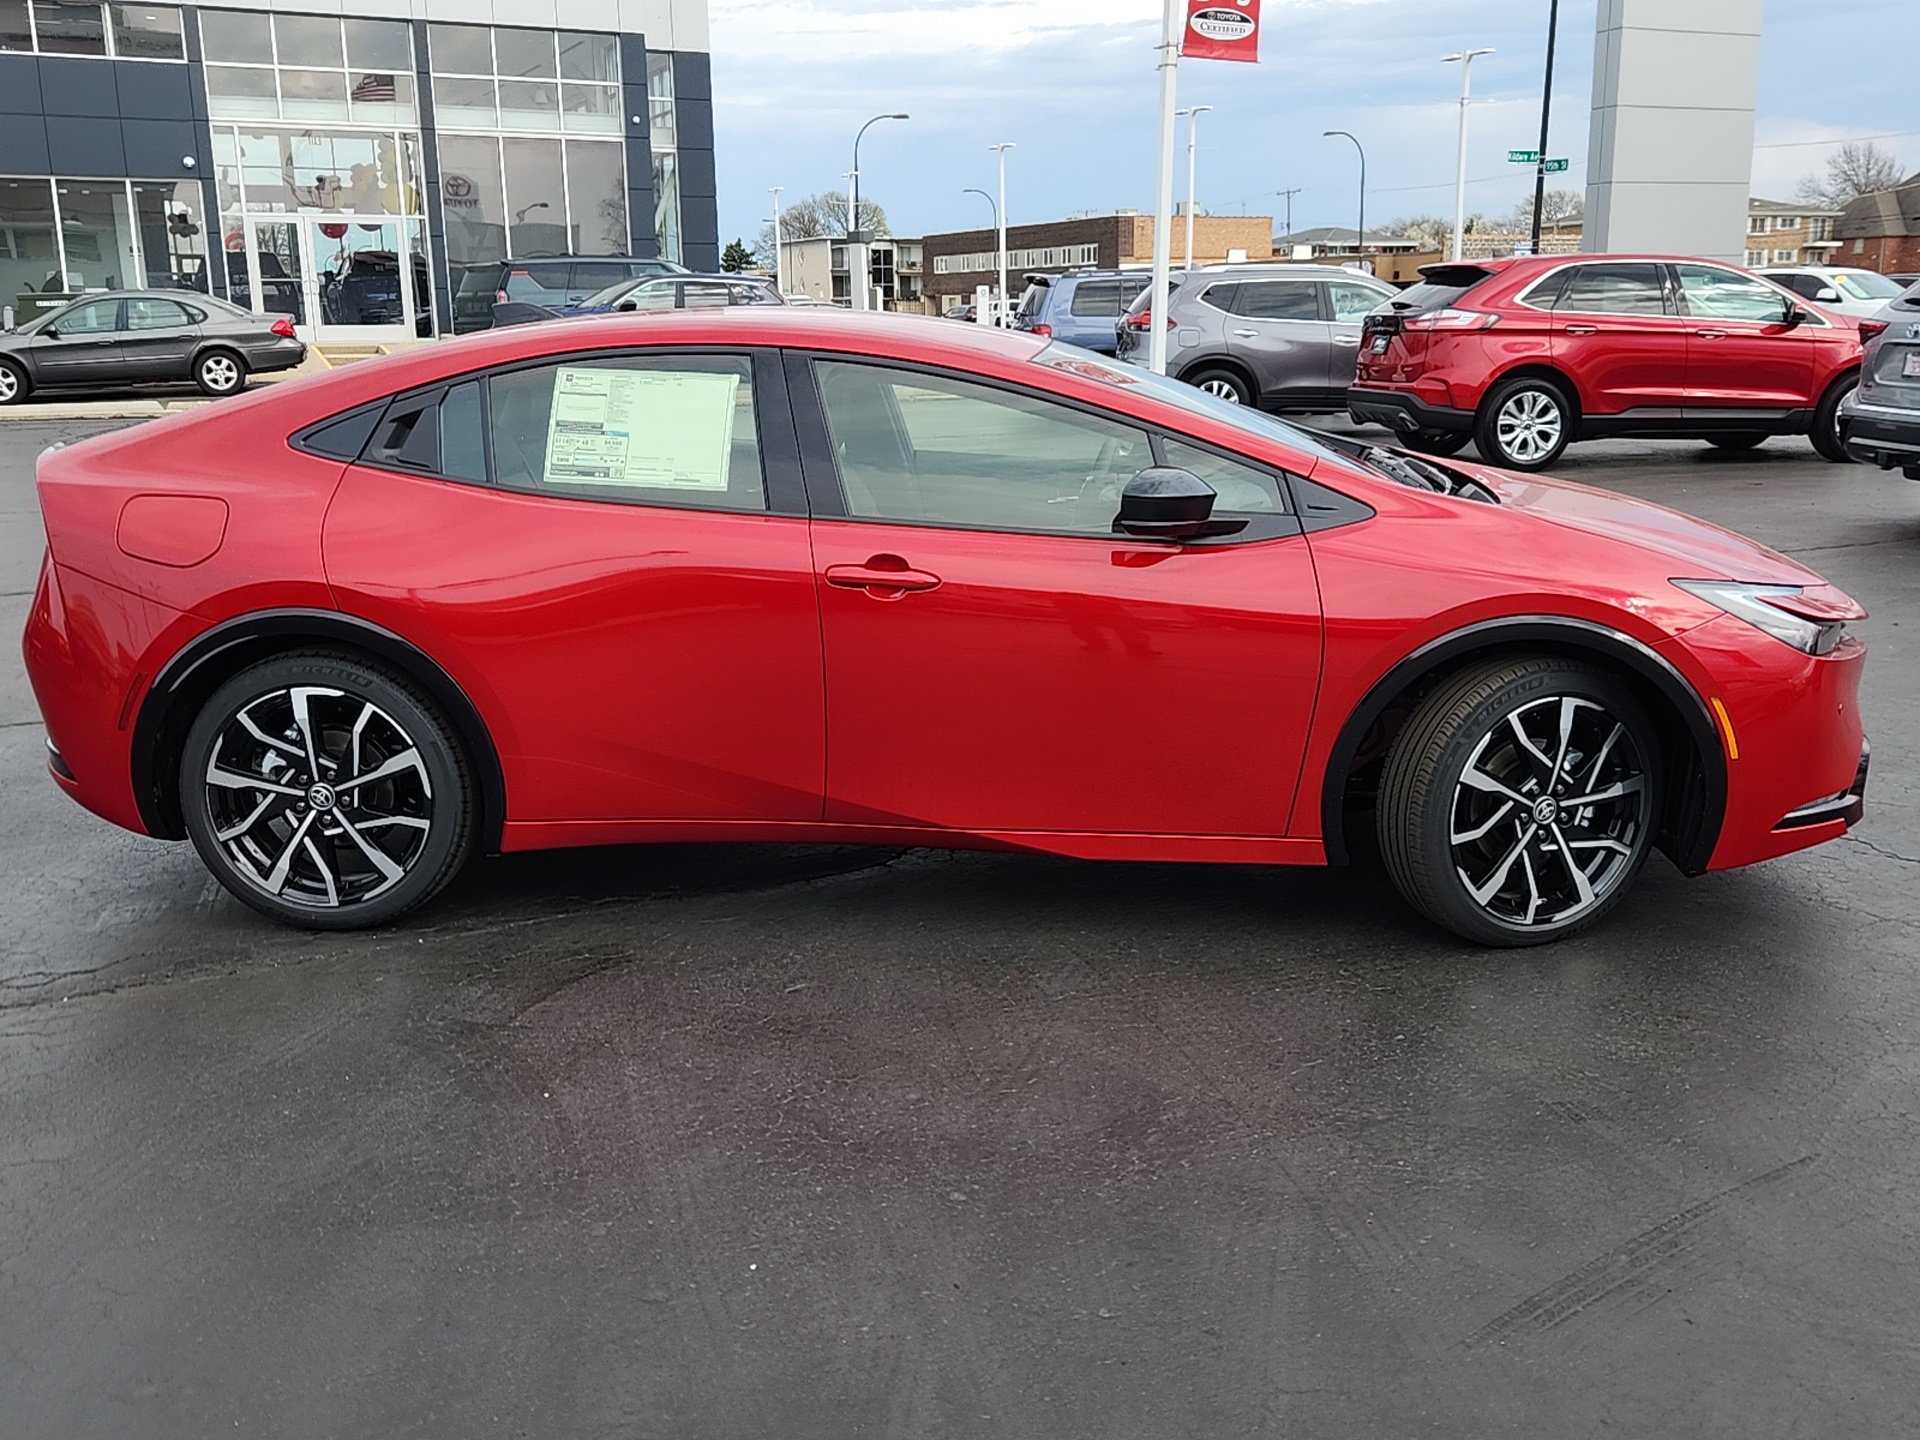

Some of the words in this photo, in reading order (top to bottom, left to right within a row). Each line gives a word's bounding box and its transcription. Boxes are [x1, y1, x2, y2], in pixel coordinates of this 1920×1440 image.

[1217, 13, 1241, 21] TOYOTA
[1199, 22, 1246, 34] CERTIFIED
[1547, 161, 1559, 170] 95th
[1561, 161, 1567, 169] St
[291, 666, 368, 686] MICHELIN
[1477, 678, 1543, 722] MICHELIN
